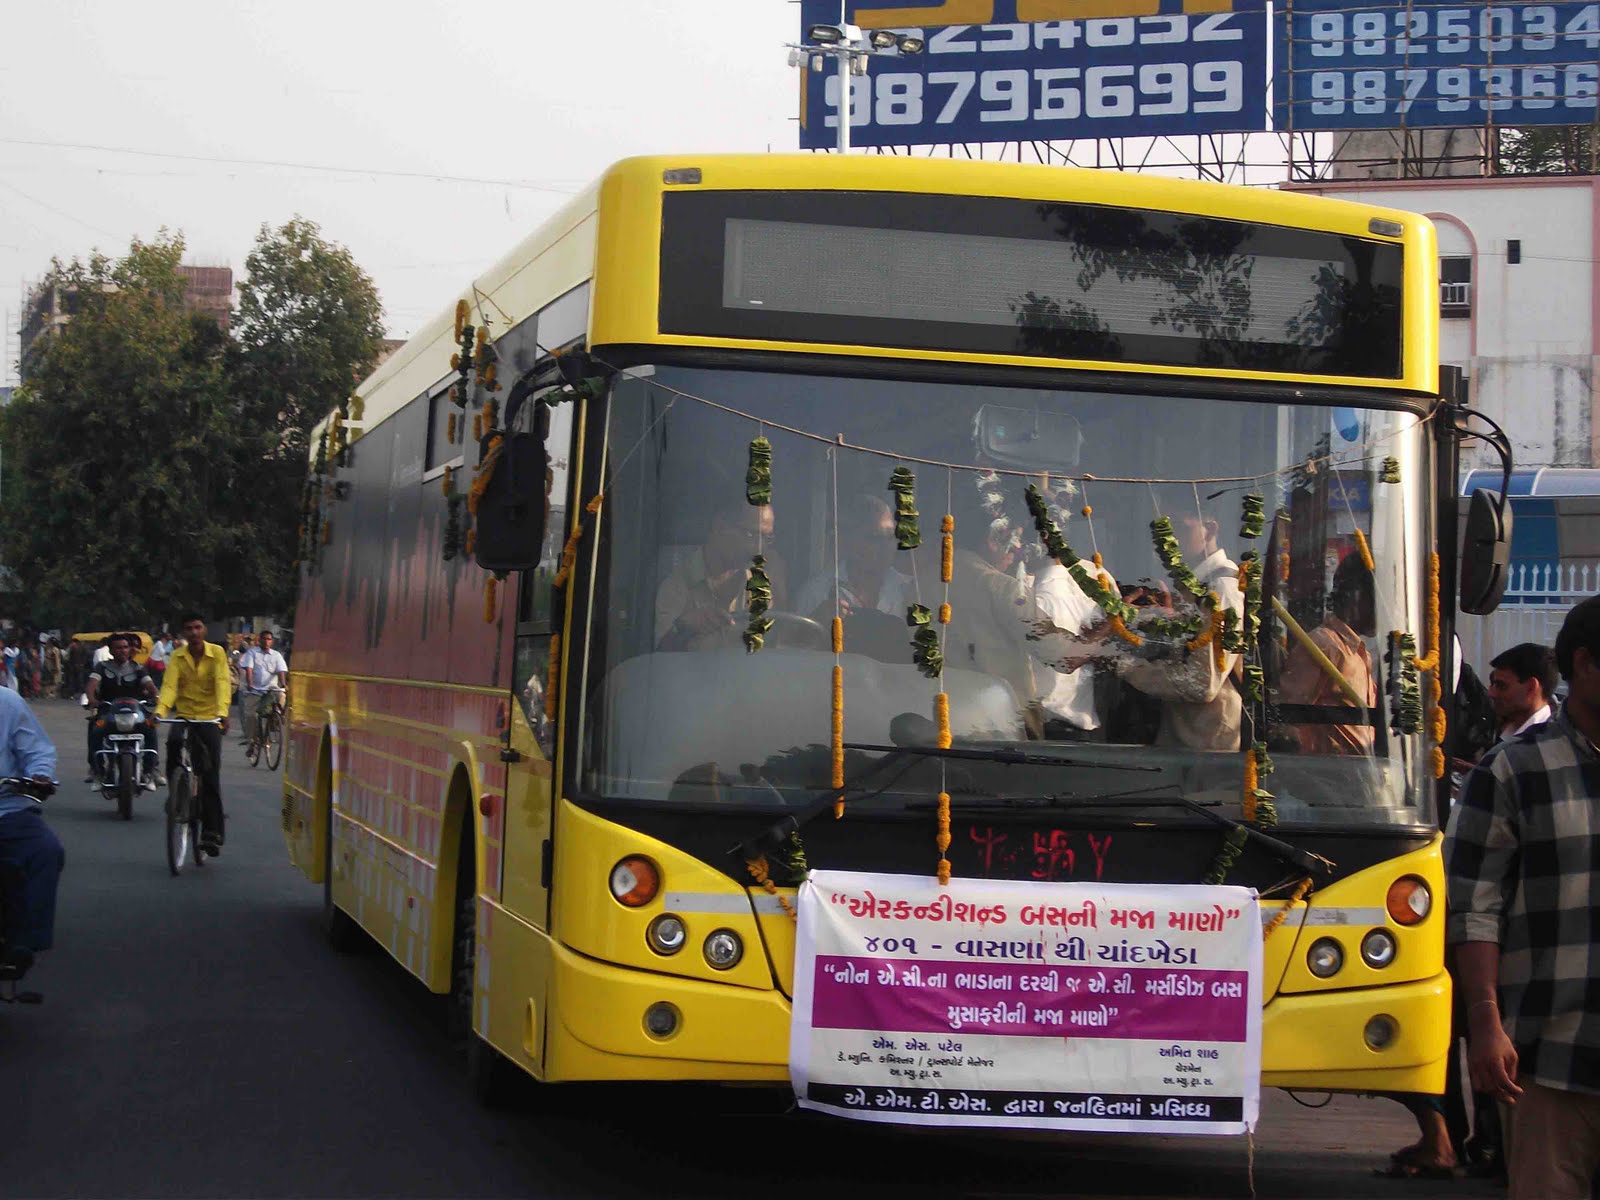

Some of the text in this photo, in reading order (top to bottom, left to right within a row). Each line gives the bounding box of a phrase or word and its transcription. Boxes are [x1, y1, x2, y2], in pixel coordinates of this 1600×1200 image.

[1311, 4, 1600, 56] 9825034
[1311, 64, 1599, 115] 9879366
[1020, 899, 1097, 928] બસની
[1110, 908, 1155, 930] મજા
[955, 939, 1043, 960] વાસણા
[1055, 936, 1086, 961] થી
[1097, 938, 1198, 965] ચાંદખેડા
[955, 973, 1012, 991] ભાડાના
[1019, 970, 1059, 993] દરથી
[1211, 981, 1243, 998] બસ
[947, 1001, 1027, 1029] મુસાફરીની
[1034, 1008, 1064, 1026] મજા
[938, 1039, 963, 1052] પટેલ
[1159, 1045, 1219, 1060] અમિત શાહ
[1003, 1098, 1044, 1114] દ્વારા
[1053, 1096, 1142, 1116] જનહિતમાં
